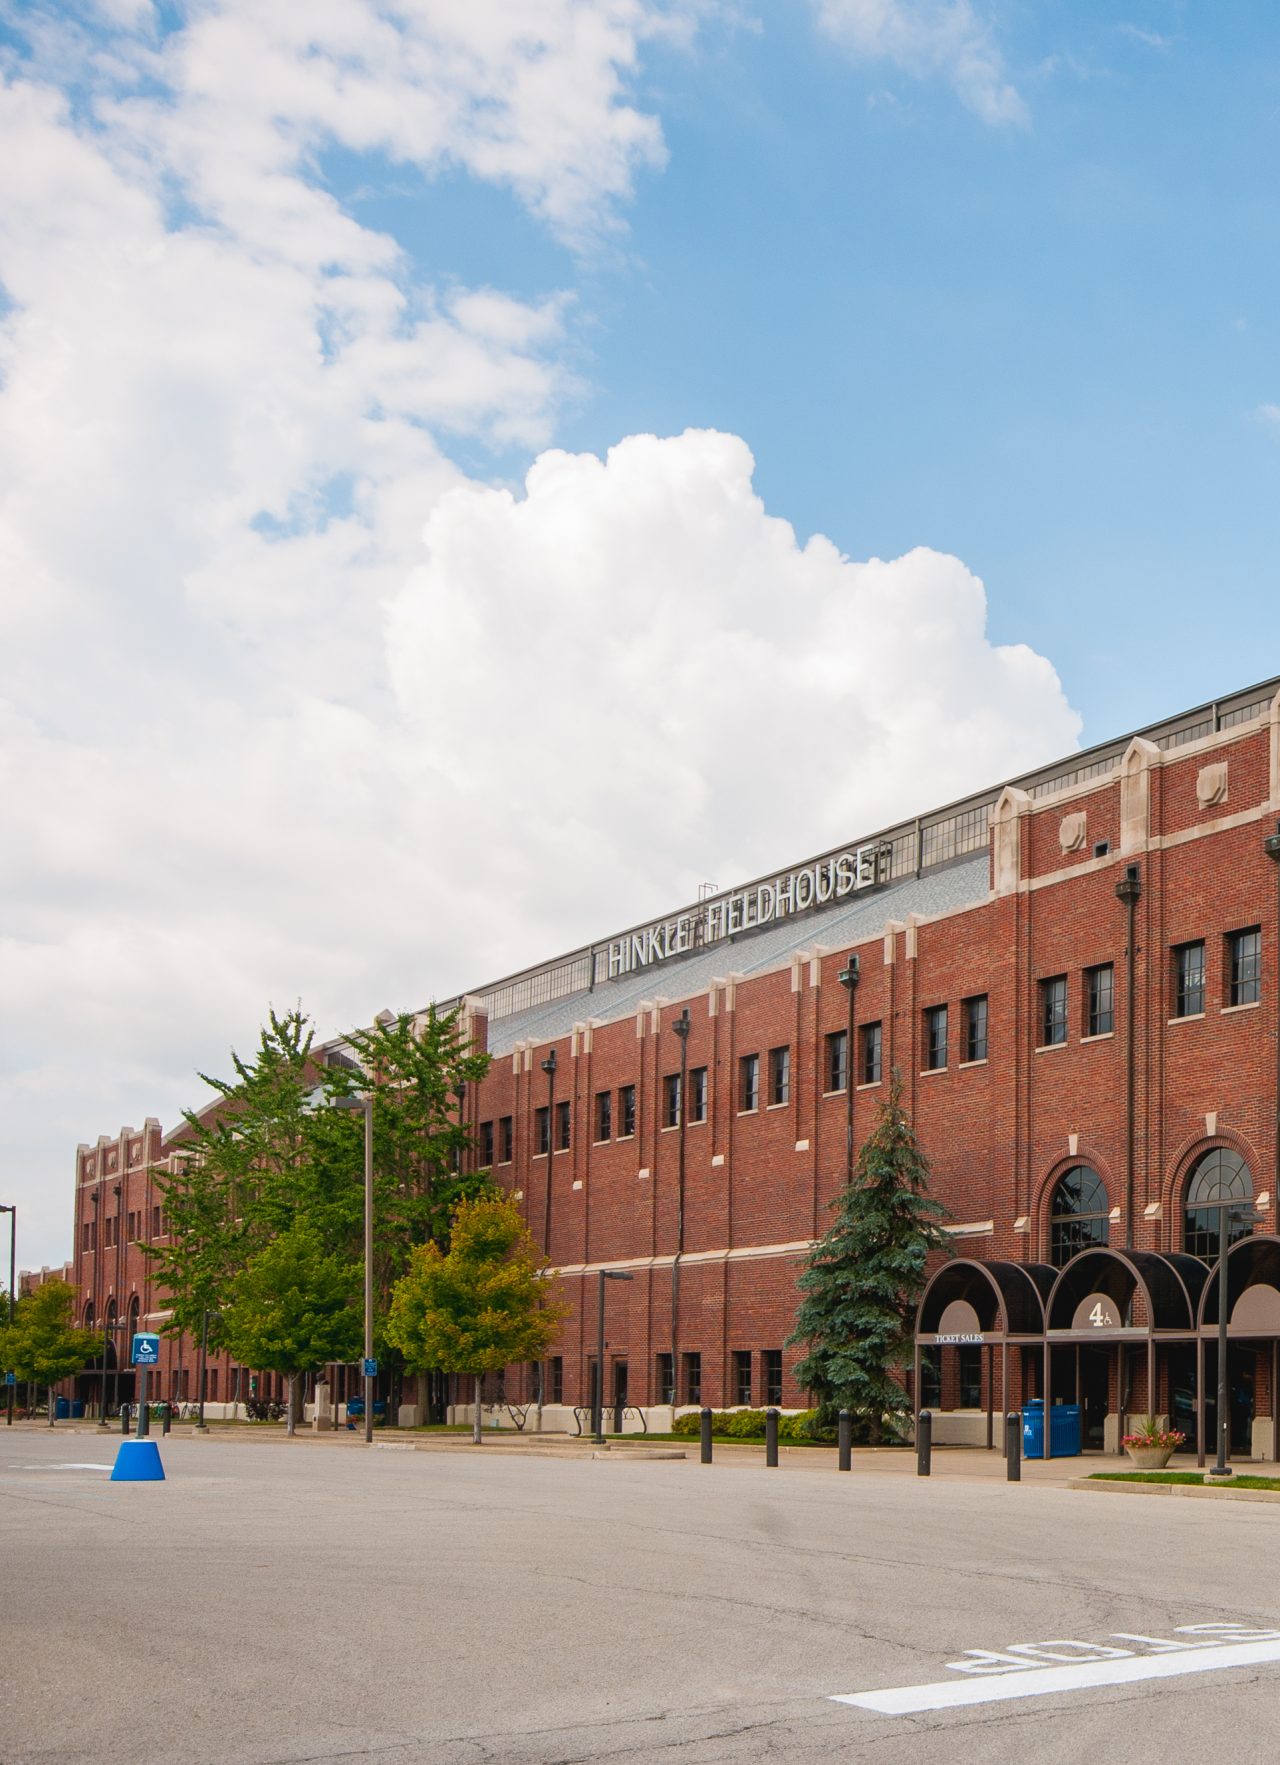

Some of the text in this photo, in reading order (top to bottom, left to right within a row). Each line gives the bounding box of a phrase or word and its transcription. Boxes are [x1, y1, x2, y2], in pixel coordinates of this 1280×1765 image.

[608, 844, 875, 978] HINKLE FIELDHOUSE
[1089, 1303, 1104, 1327] 4
[935, 1333, 984, 1343] TICKET SALES
